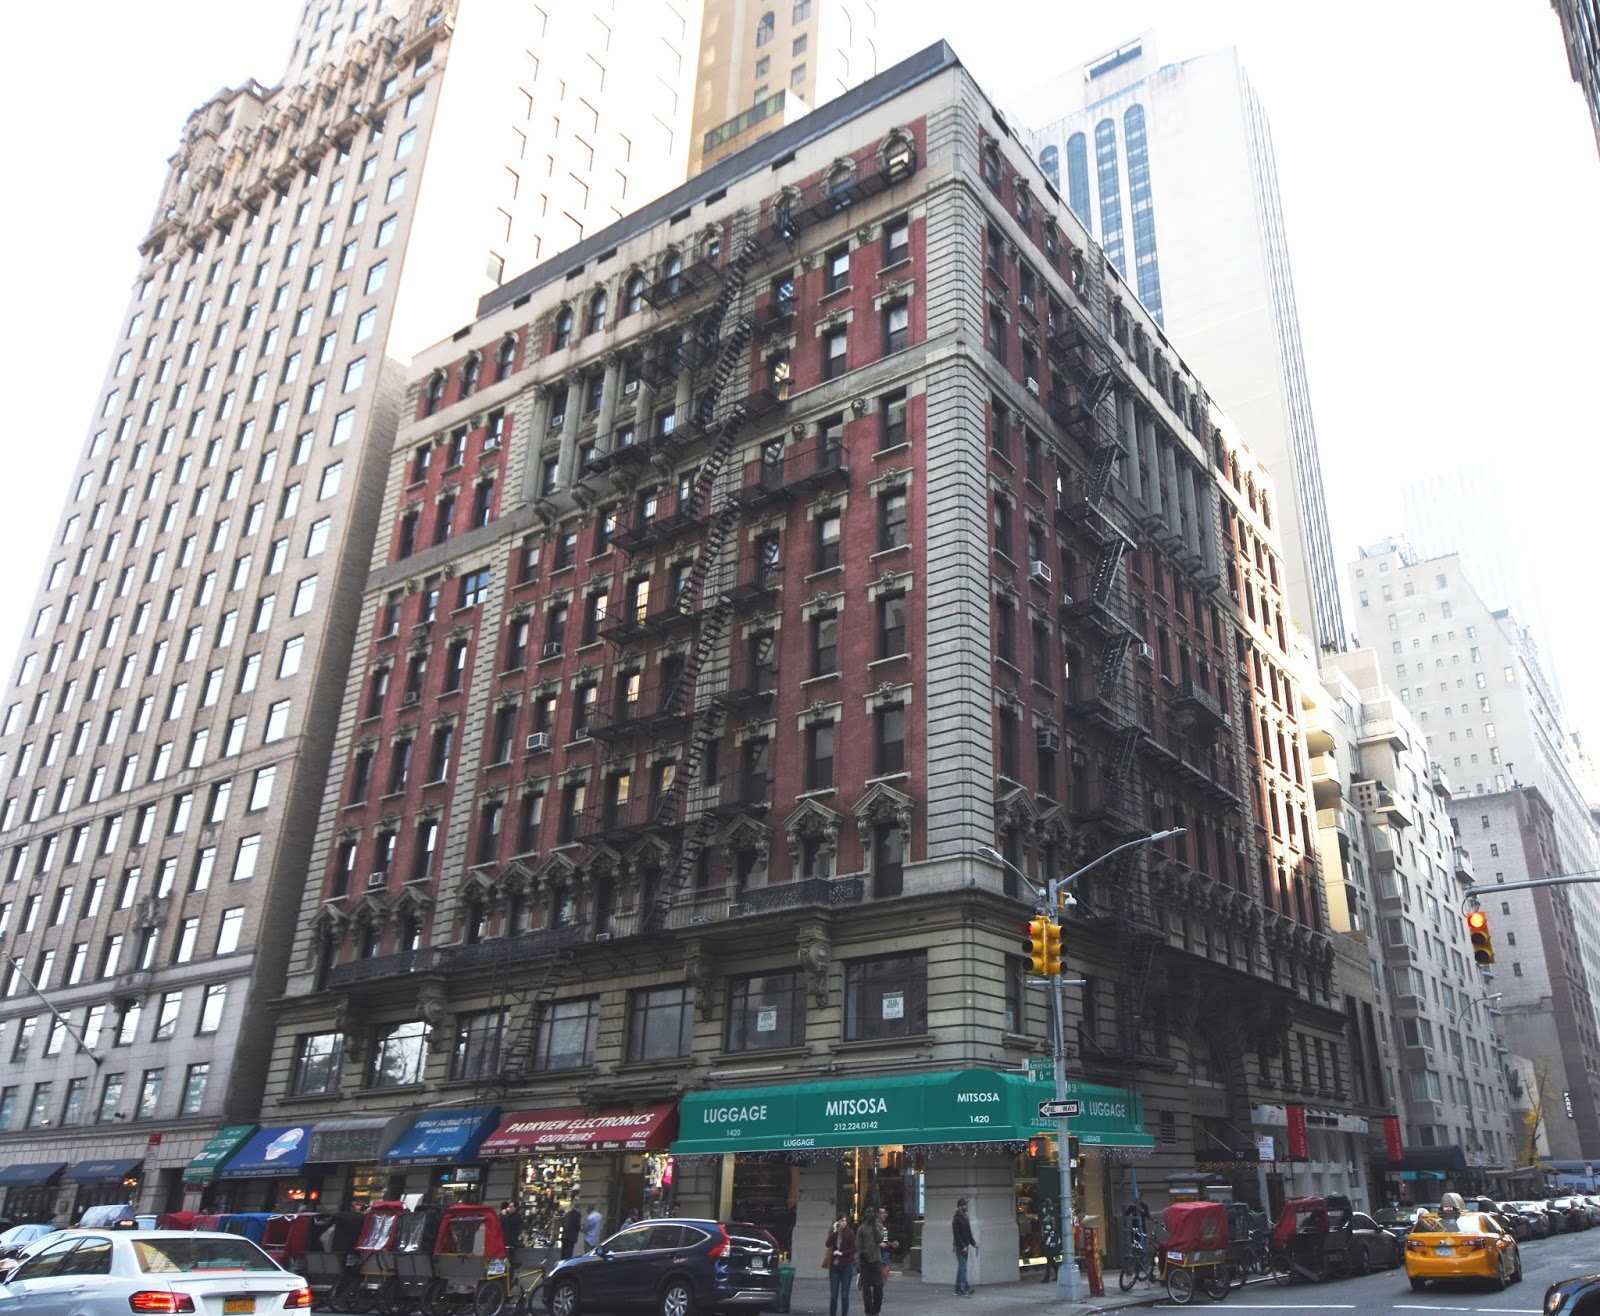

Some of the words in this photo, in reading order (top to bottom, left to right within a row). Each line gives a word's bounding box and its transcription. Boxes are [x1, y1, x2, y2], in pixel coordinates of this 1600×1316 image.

[1029, 1062, 1054, 1070] Americas
[1039, 1071, 1044, 1081] 6
[957, 1092, 1000, 1103] MITSOSA
[825, 1098, 888, 1116] MITSOSA
[1043, 1104, 1057, 1113] ONE
[1061, 1103, 1076, 1112] WAY
[1089, 1101, 1126, 1118] LUGGAGE
[703, 1105, 768, 1123] LUGGAGE
[969, 1115, 990, 1123] 1420
[505, 1119, 570, 1133] PARKVIEW
[567, 1113, 655, 1130] ELECTRONICS
[834, 1121, 878, 1131] 212.224.0142
[534, 1132, 596, 1144] SOUVENIRS
[726, 1129, 741, 1137] 1420
[783, 1138, 815, 1147] LUGGAGE
[1083, 1135, 1101, 1143] LUGGAGE
[602, 1141, 619, 1149] Nikon
[1236, 1151, 1245, 1159] 57
